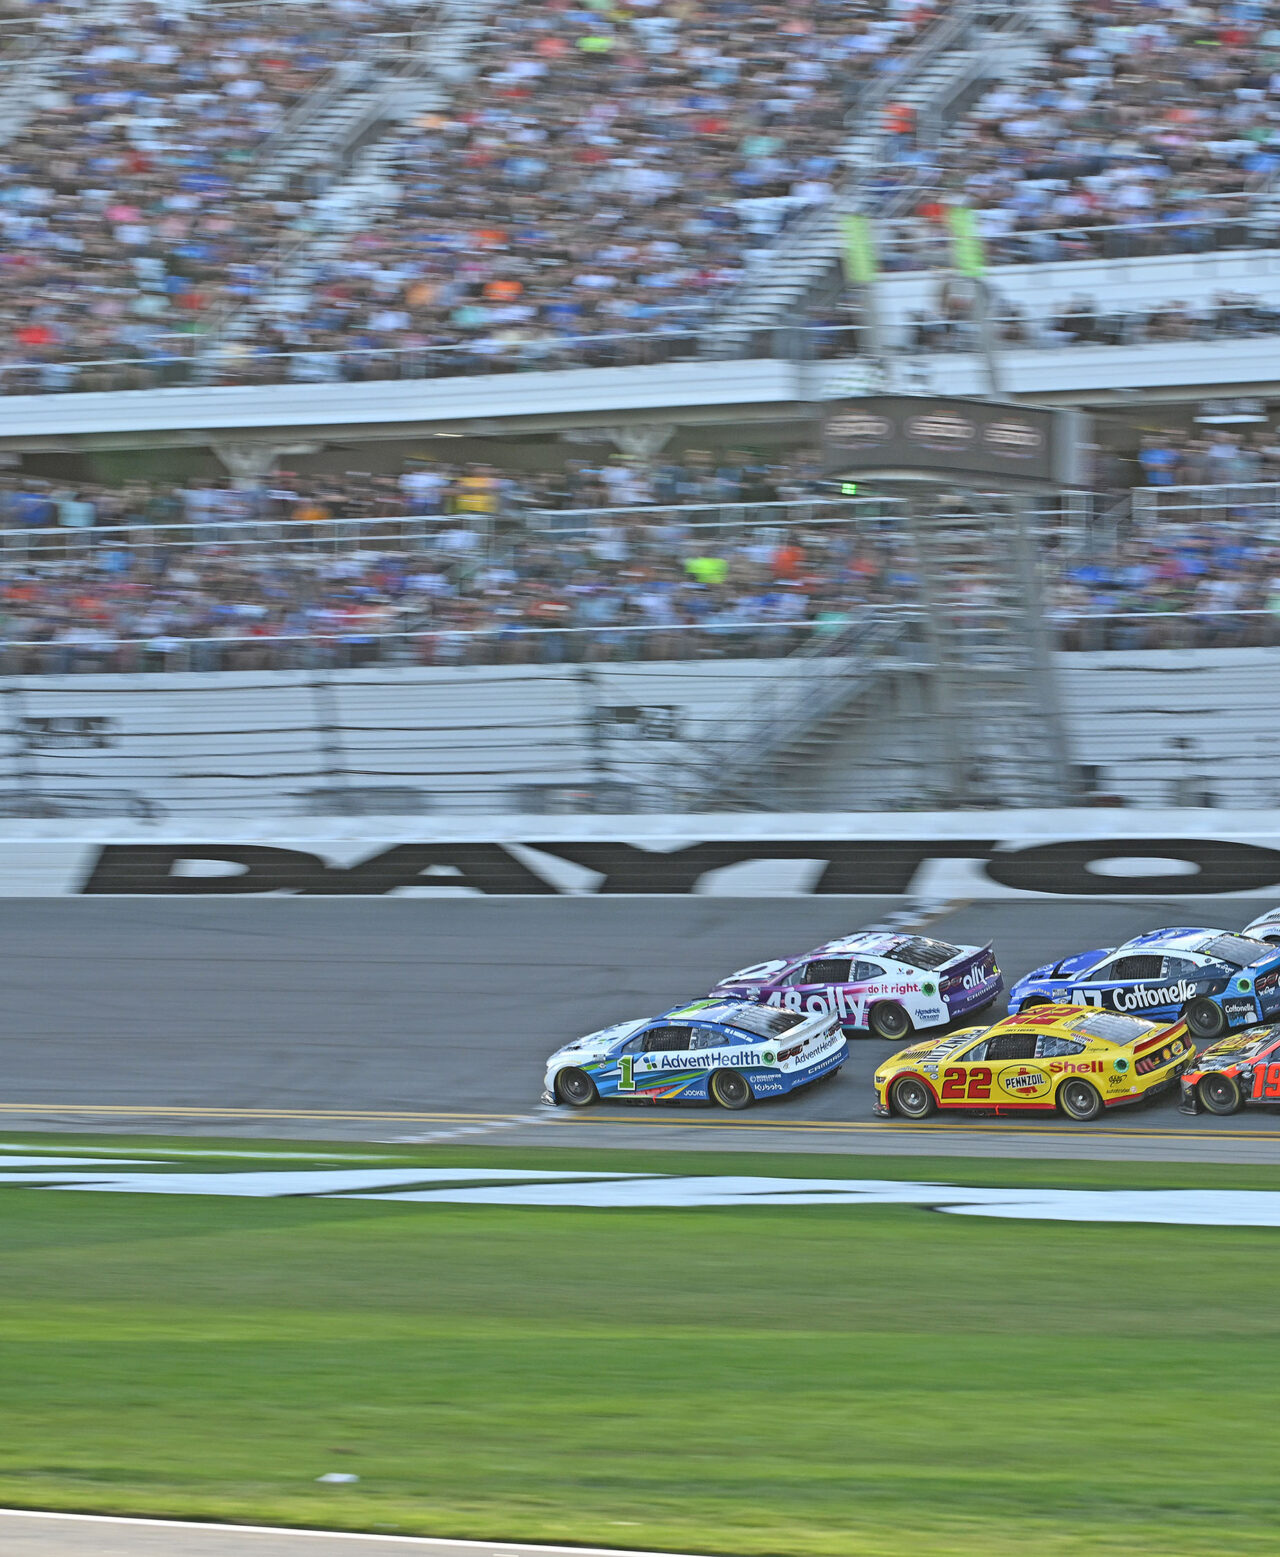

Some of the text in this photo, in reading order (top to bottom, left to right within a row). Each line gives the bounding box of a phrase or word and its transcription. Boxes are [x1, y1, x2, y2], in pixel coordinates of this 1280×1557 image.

[963, 961, 988, 990] ally
[868, 982, 922, 995] do it right.
[1113, 979, 1197, 1012] Cottonelle
[806, 986, 867, 1027] ally
[1225, 1003, 1255, 1013] Cottonelle
[661, 1050, 761, 1069] AdventHealth
[794, 1033, 839, 1066] AdventHealth
[616, 1054, 637, 1092] 1
[807, 1052, 842, 1075] CAMARO
[1050, 1060, 1104, 1074] Shell
[754, 1083, 783, 1092] Kubota
[941, 1067, 993, 1100] 22
[1004, 1073, 1047, 1090] PENNZOIL
